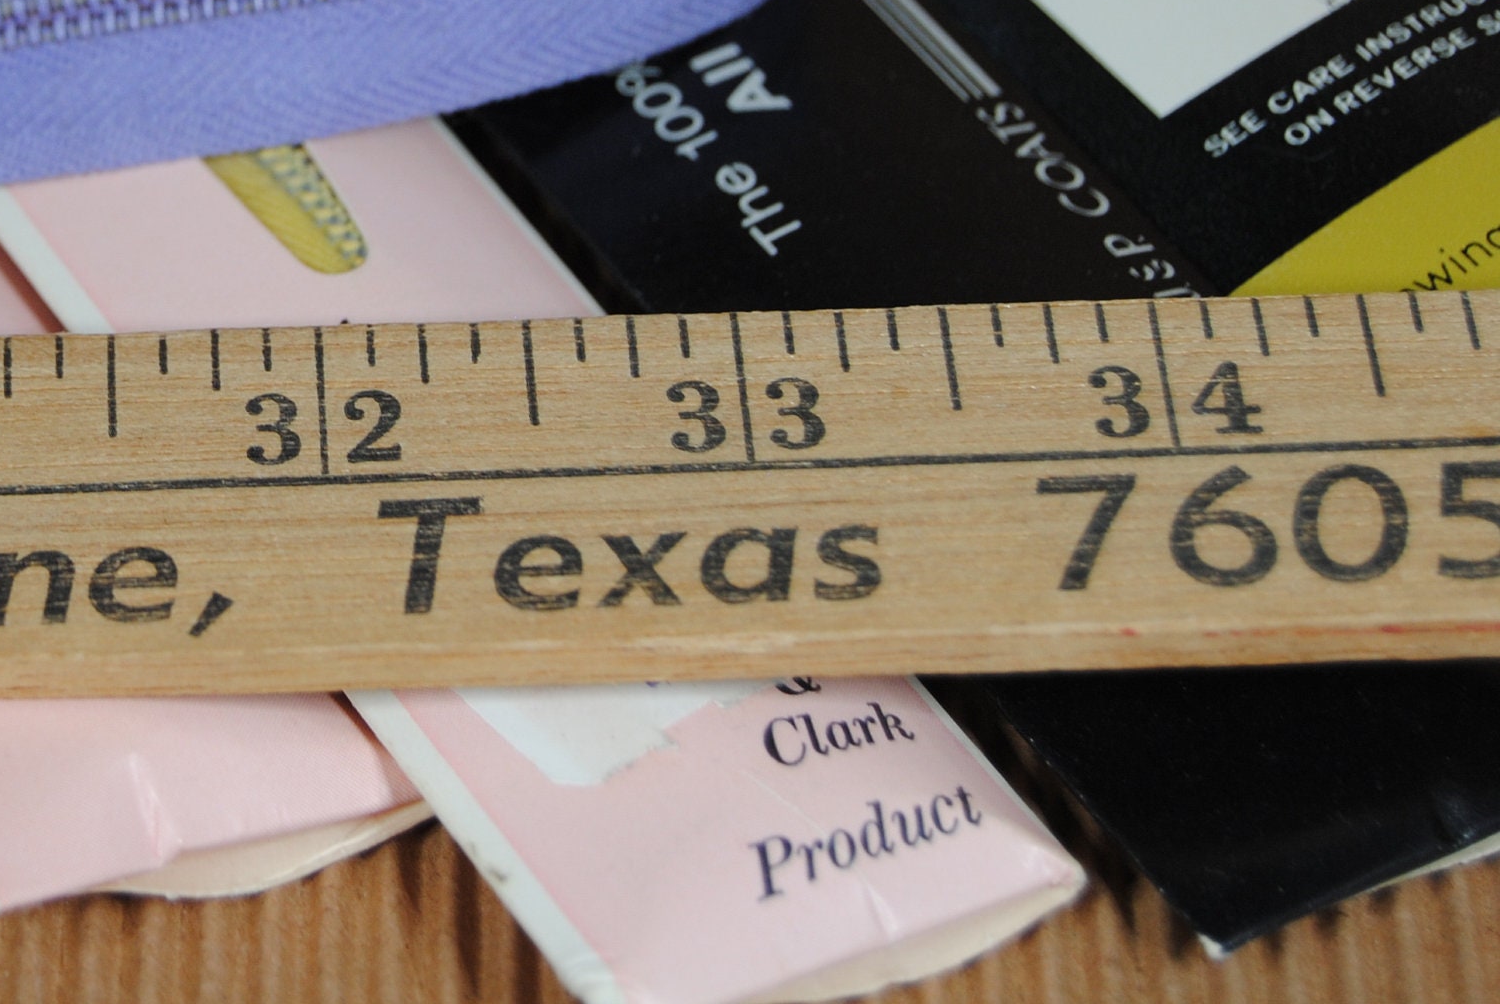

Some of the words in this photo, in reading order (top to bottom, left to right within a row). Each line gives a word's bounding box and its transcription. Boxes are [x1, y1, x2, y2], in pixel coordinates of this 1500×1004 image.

[689, 42, 793, 114] All
[1203, 108, 1268, 158] SEE
[1267, 53, 1356, 115] CARE
[1283, 107, 1336, 146] ON
[1333, 26, 1478, 116] REVERSE
[715, 162, 802, 256] The
[975, 102, 1111, 218] COATS
[377, 497, 882, 616] Texas
[1035, 461, 1500, 592] 7605
[763, 700, 916, 766] Clark
[747, 785, 982, 902] Product
